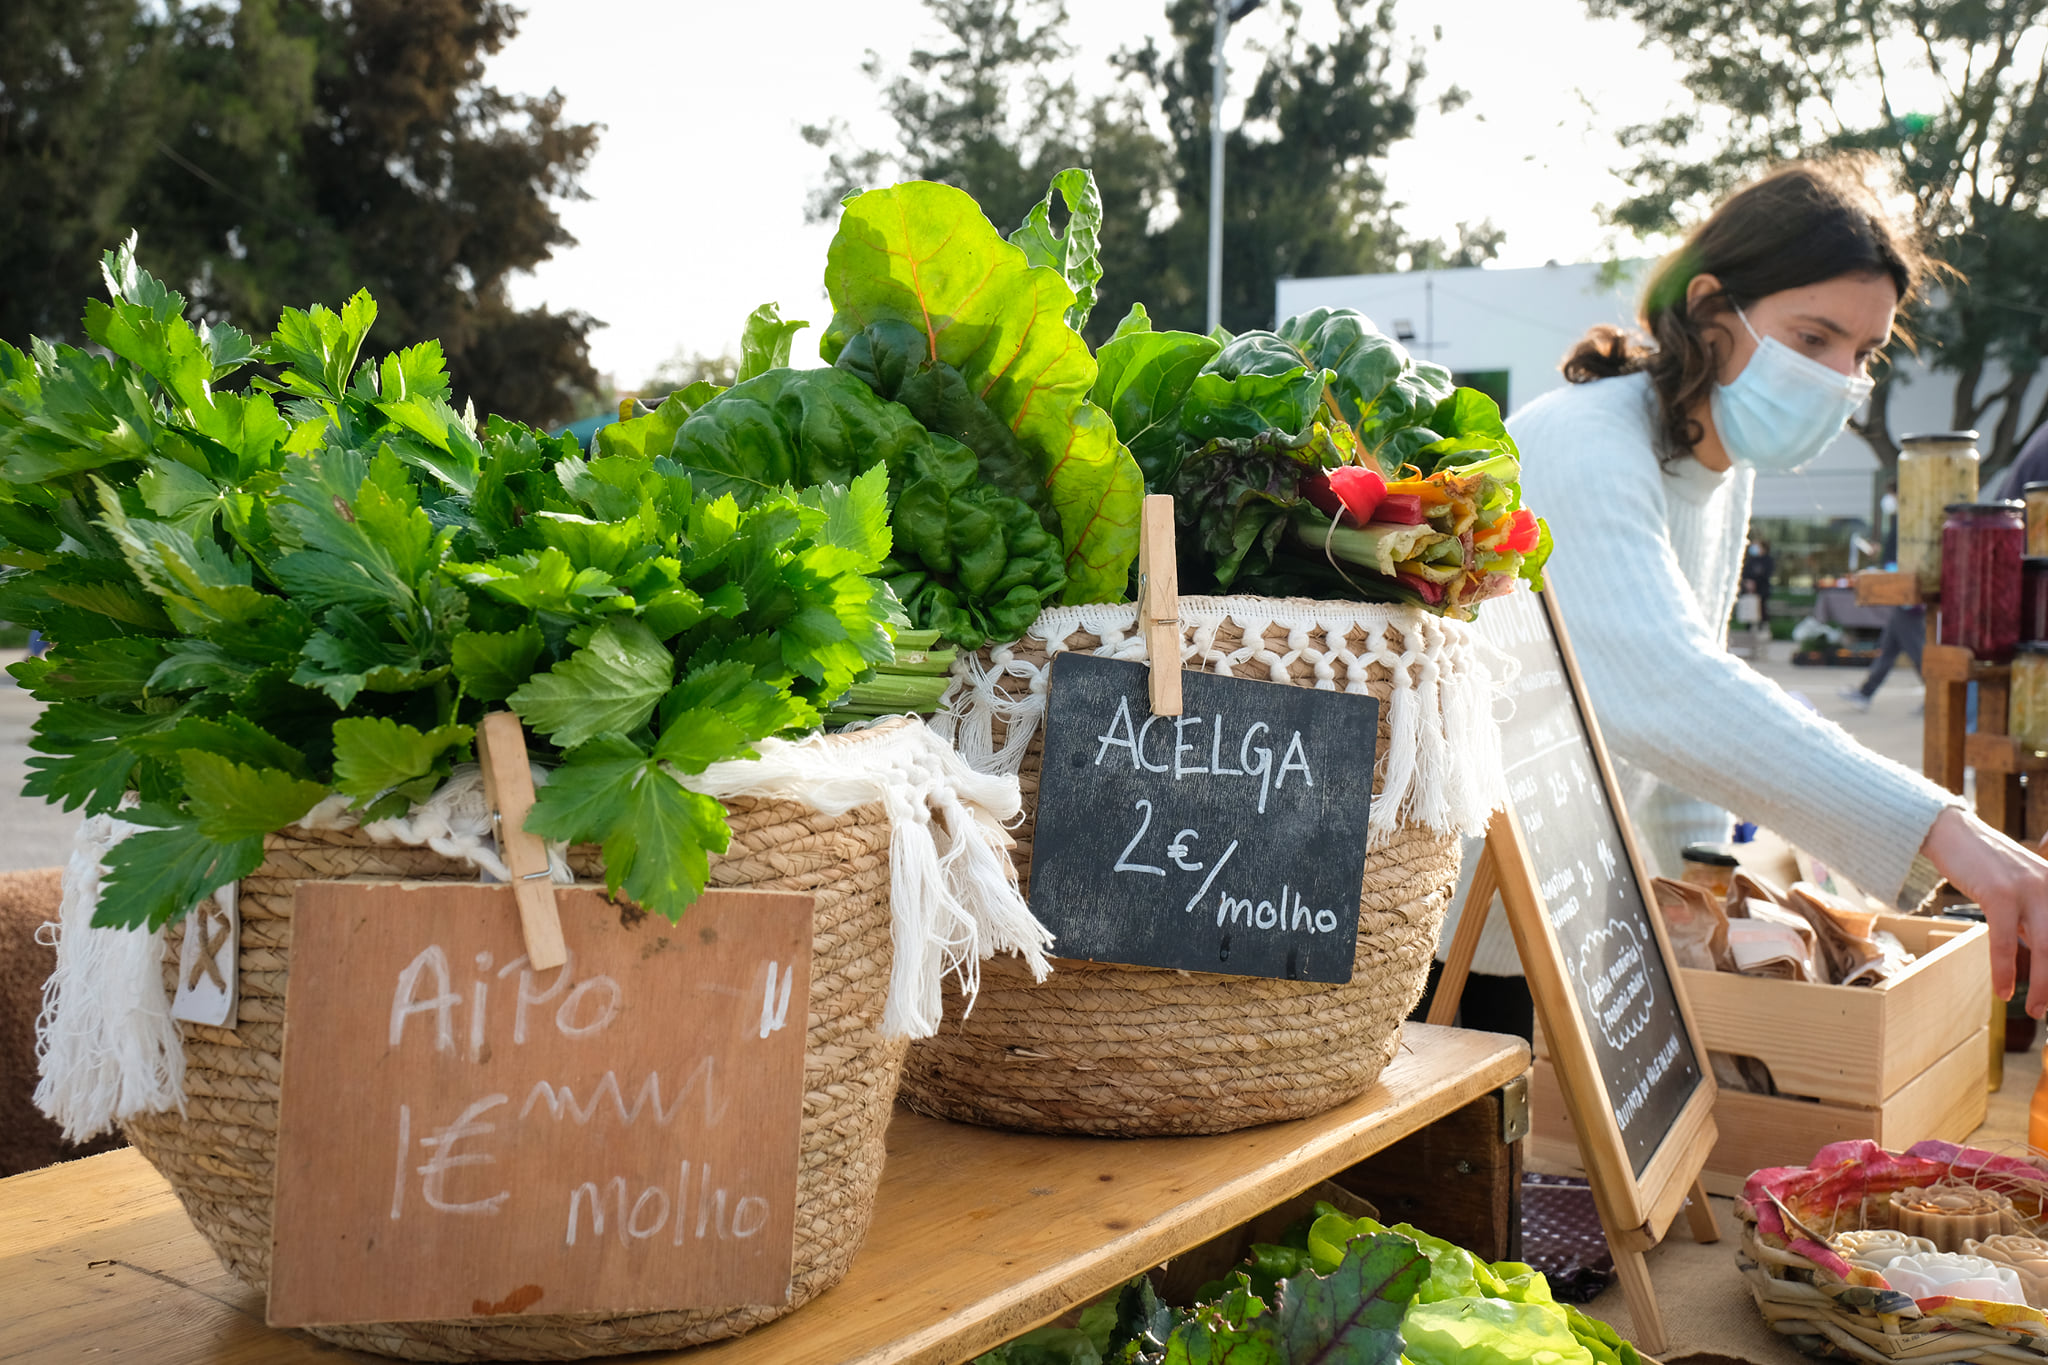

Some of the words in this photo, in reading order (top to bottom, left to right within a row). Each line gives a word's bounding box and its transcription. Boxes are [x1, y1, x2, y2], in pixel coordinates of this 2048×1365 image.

[1095, 695, 1314, 814] ACELGA
[1216, 885, 1338, 935] molho
[389, 1093, 510, 1219] 1€
[565, 1159, 770, 1247] molho
